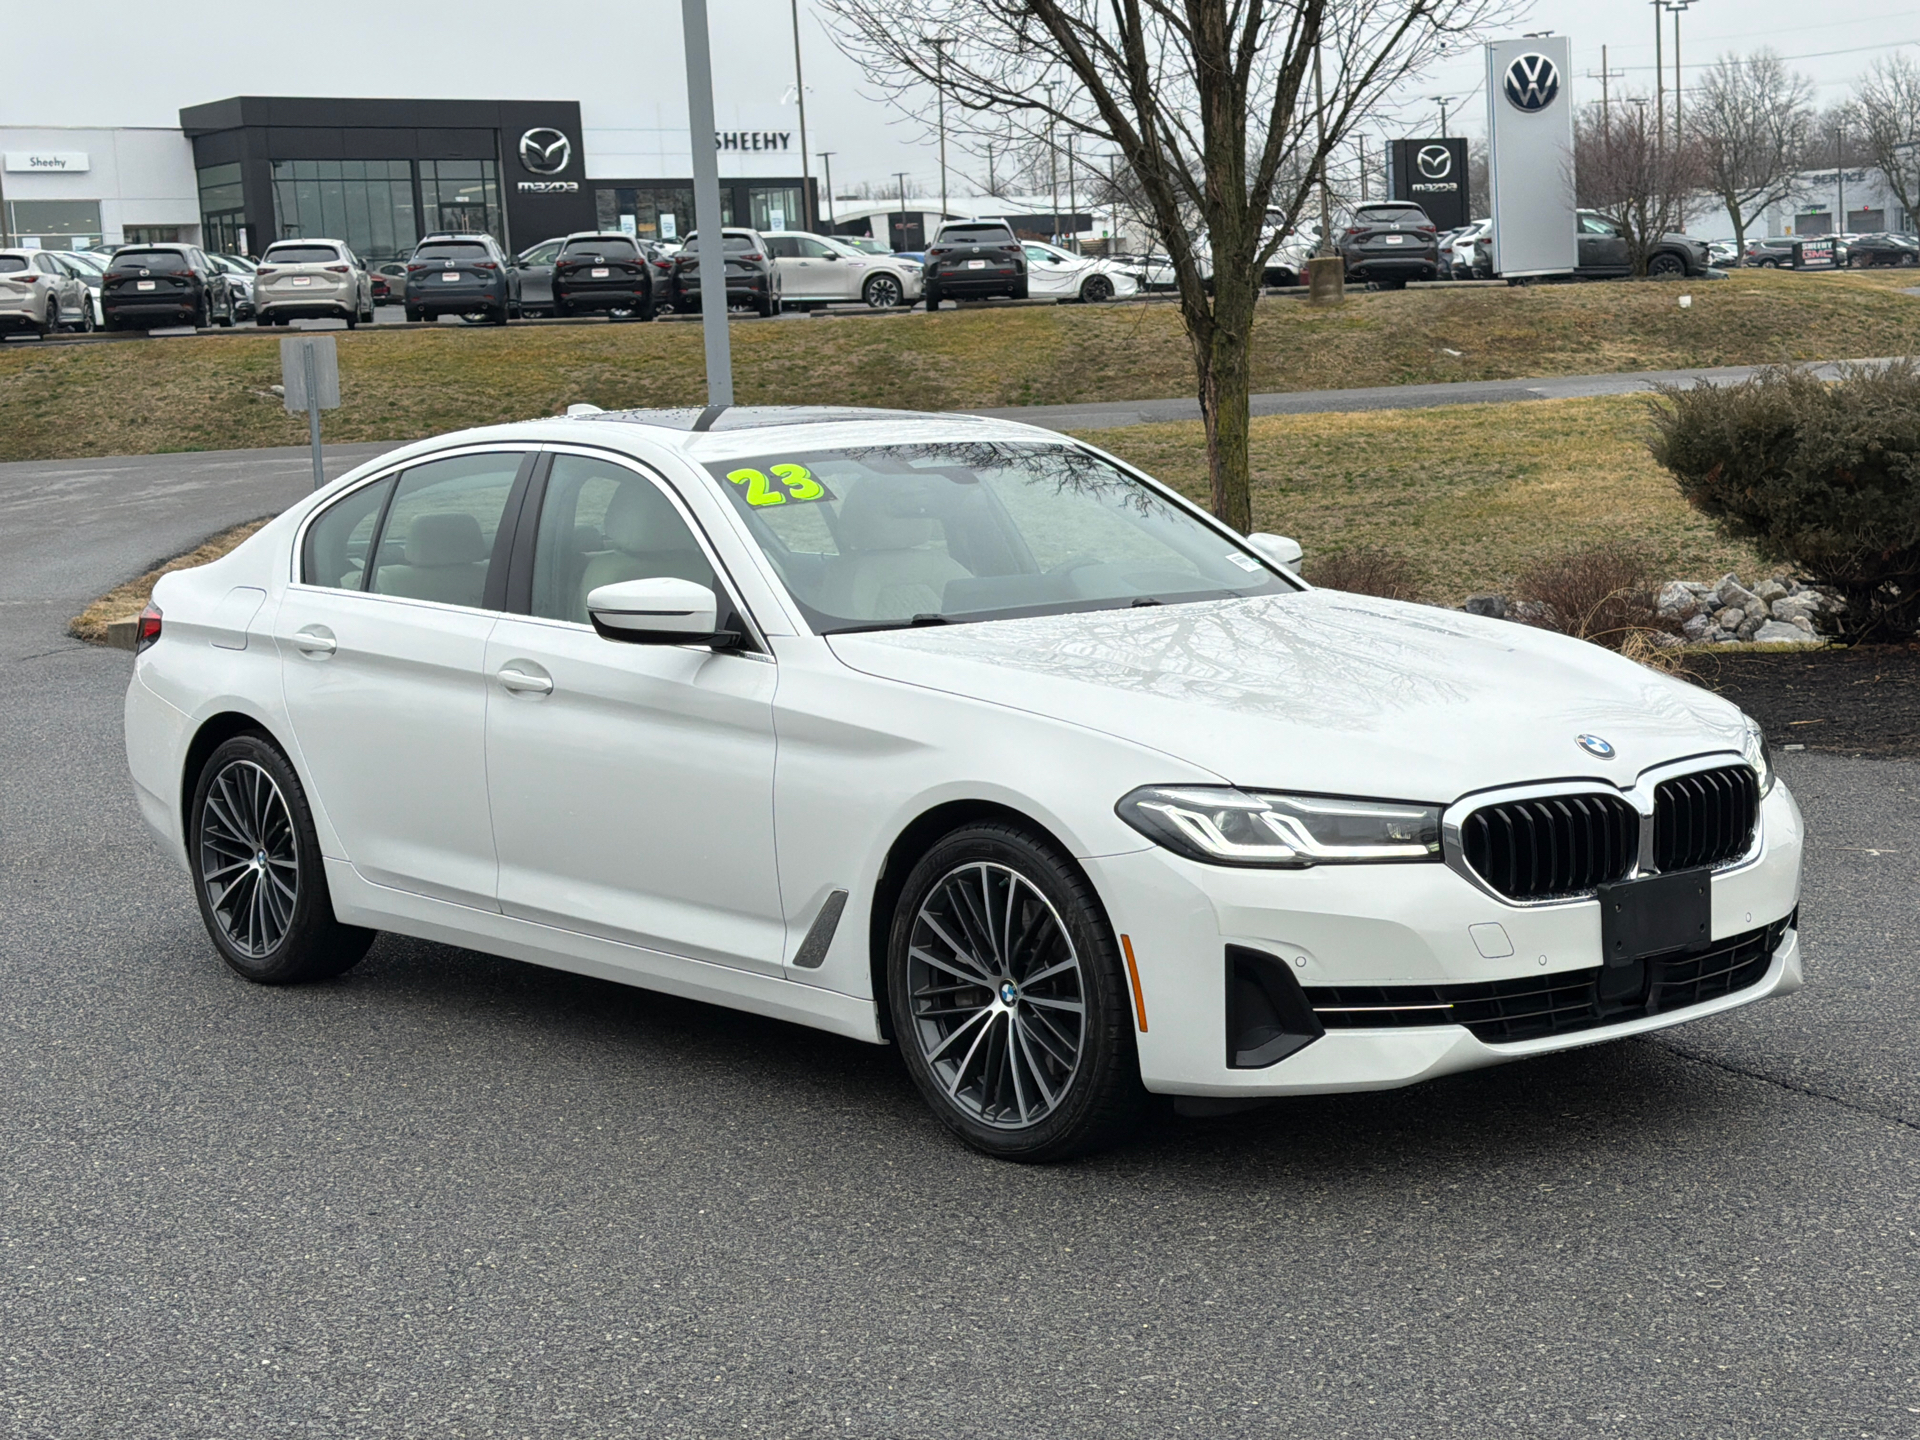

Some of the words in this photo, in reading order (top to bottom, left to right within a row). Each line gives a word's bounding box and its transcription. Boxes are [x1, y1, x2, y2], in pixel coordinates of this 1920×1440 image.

[714, 132, 791, 150] SHEEHY
[29, 156, 66, 169] Sheehy
[1802, 249, 1834, 259] GMC
[726, 463, 825, 506] 23
